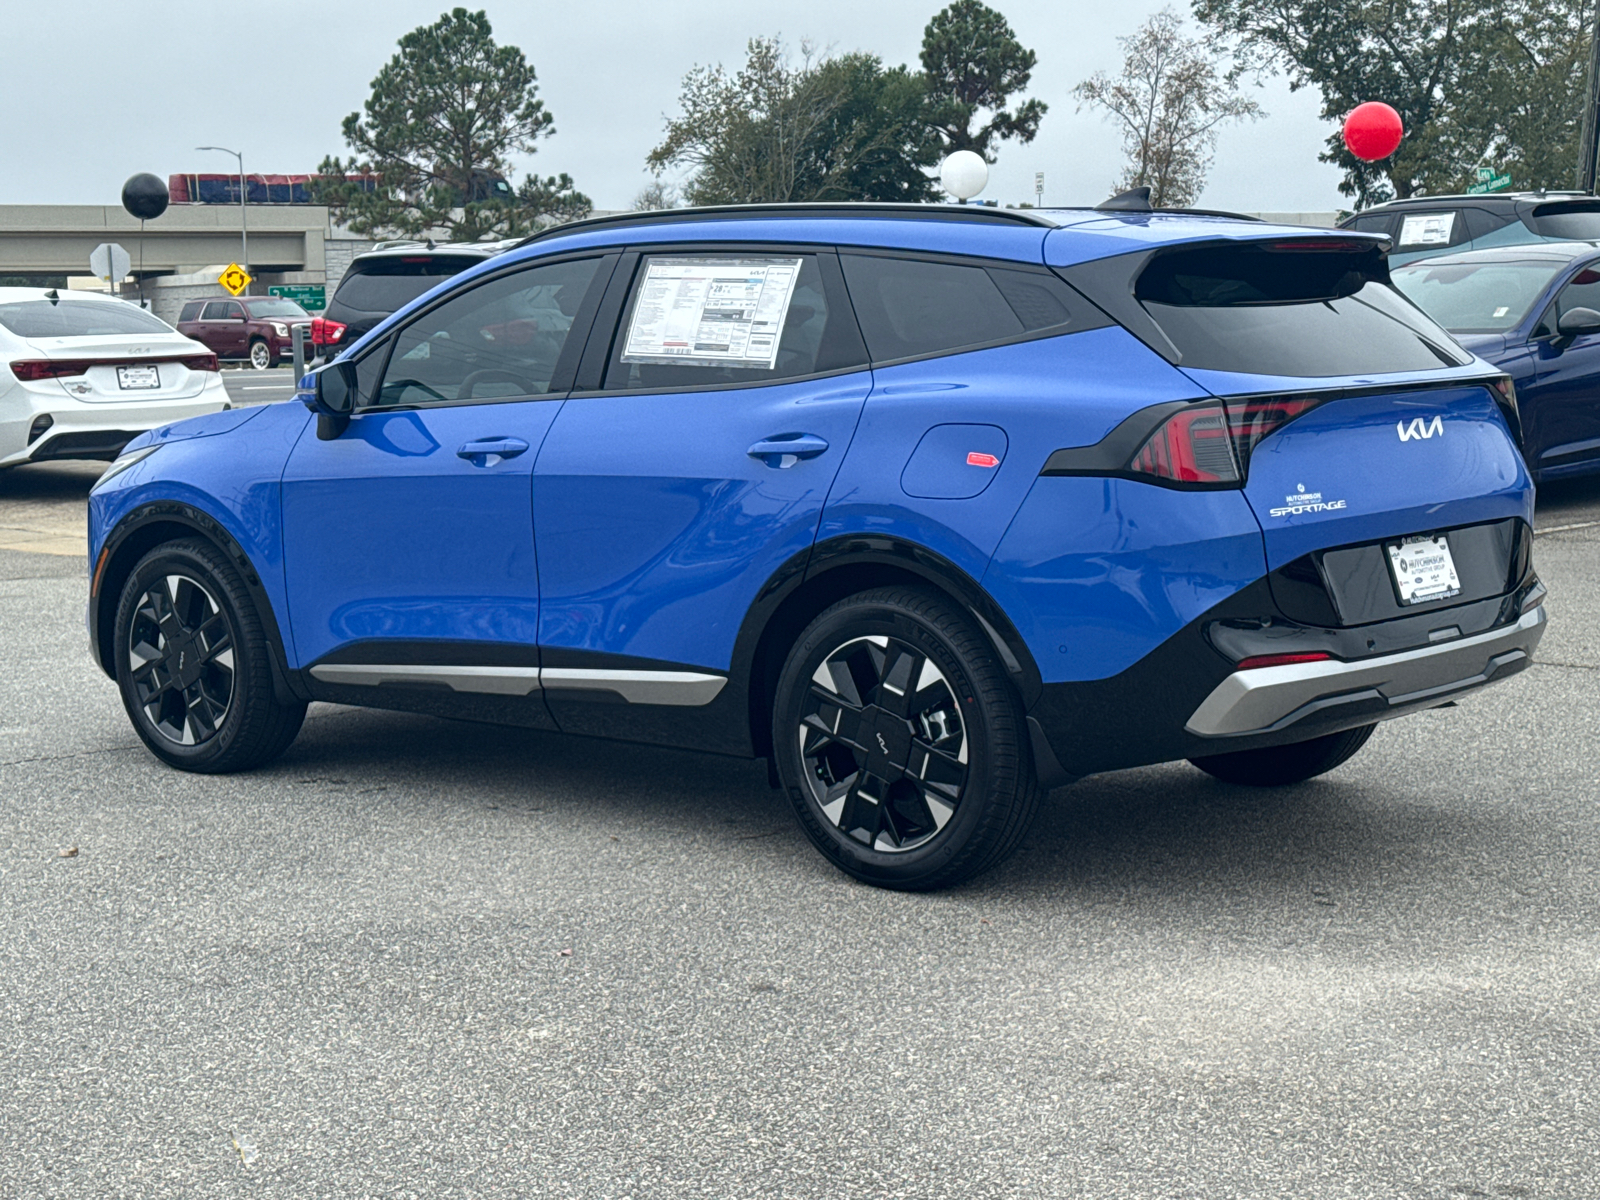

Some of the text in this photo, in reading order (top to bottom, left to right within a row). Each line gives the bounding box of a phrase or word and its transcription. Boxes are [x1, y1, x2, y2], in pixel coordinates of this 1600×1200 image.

[1396, 415, 1444, 442] KIA
[1286, 492, 1322, 502] HUTCHINSON
[1269, 499, 1347, 517] SPORTAGE
[1408, 554, 1444, 568] HUTCHINSON
[921, 632, 971, 698] MICHELIN
